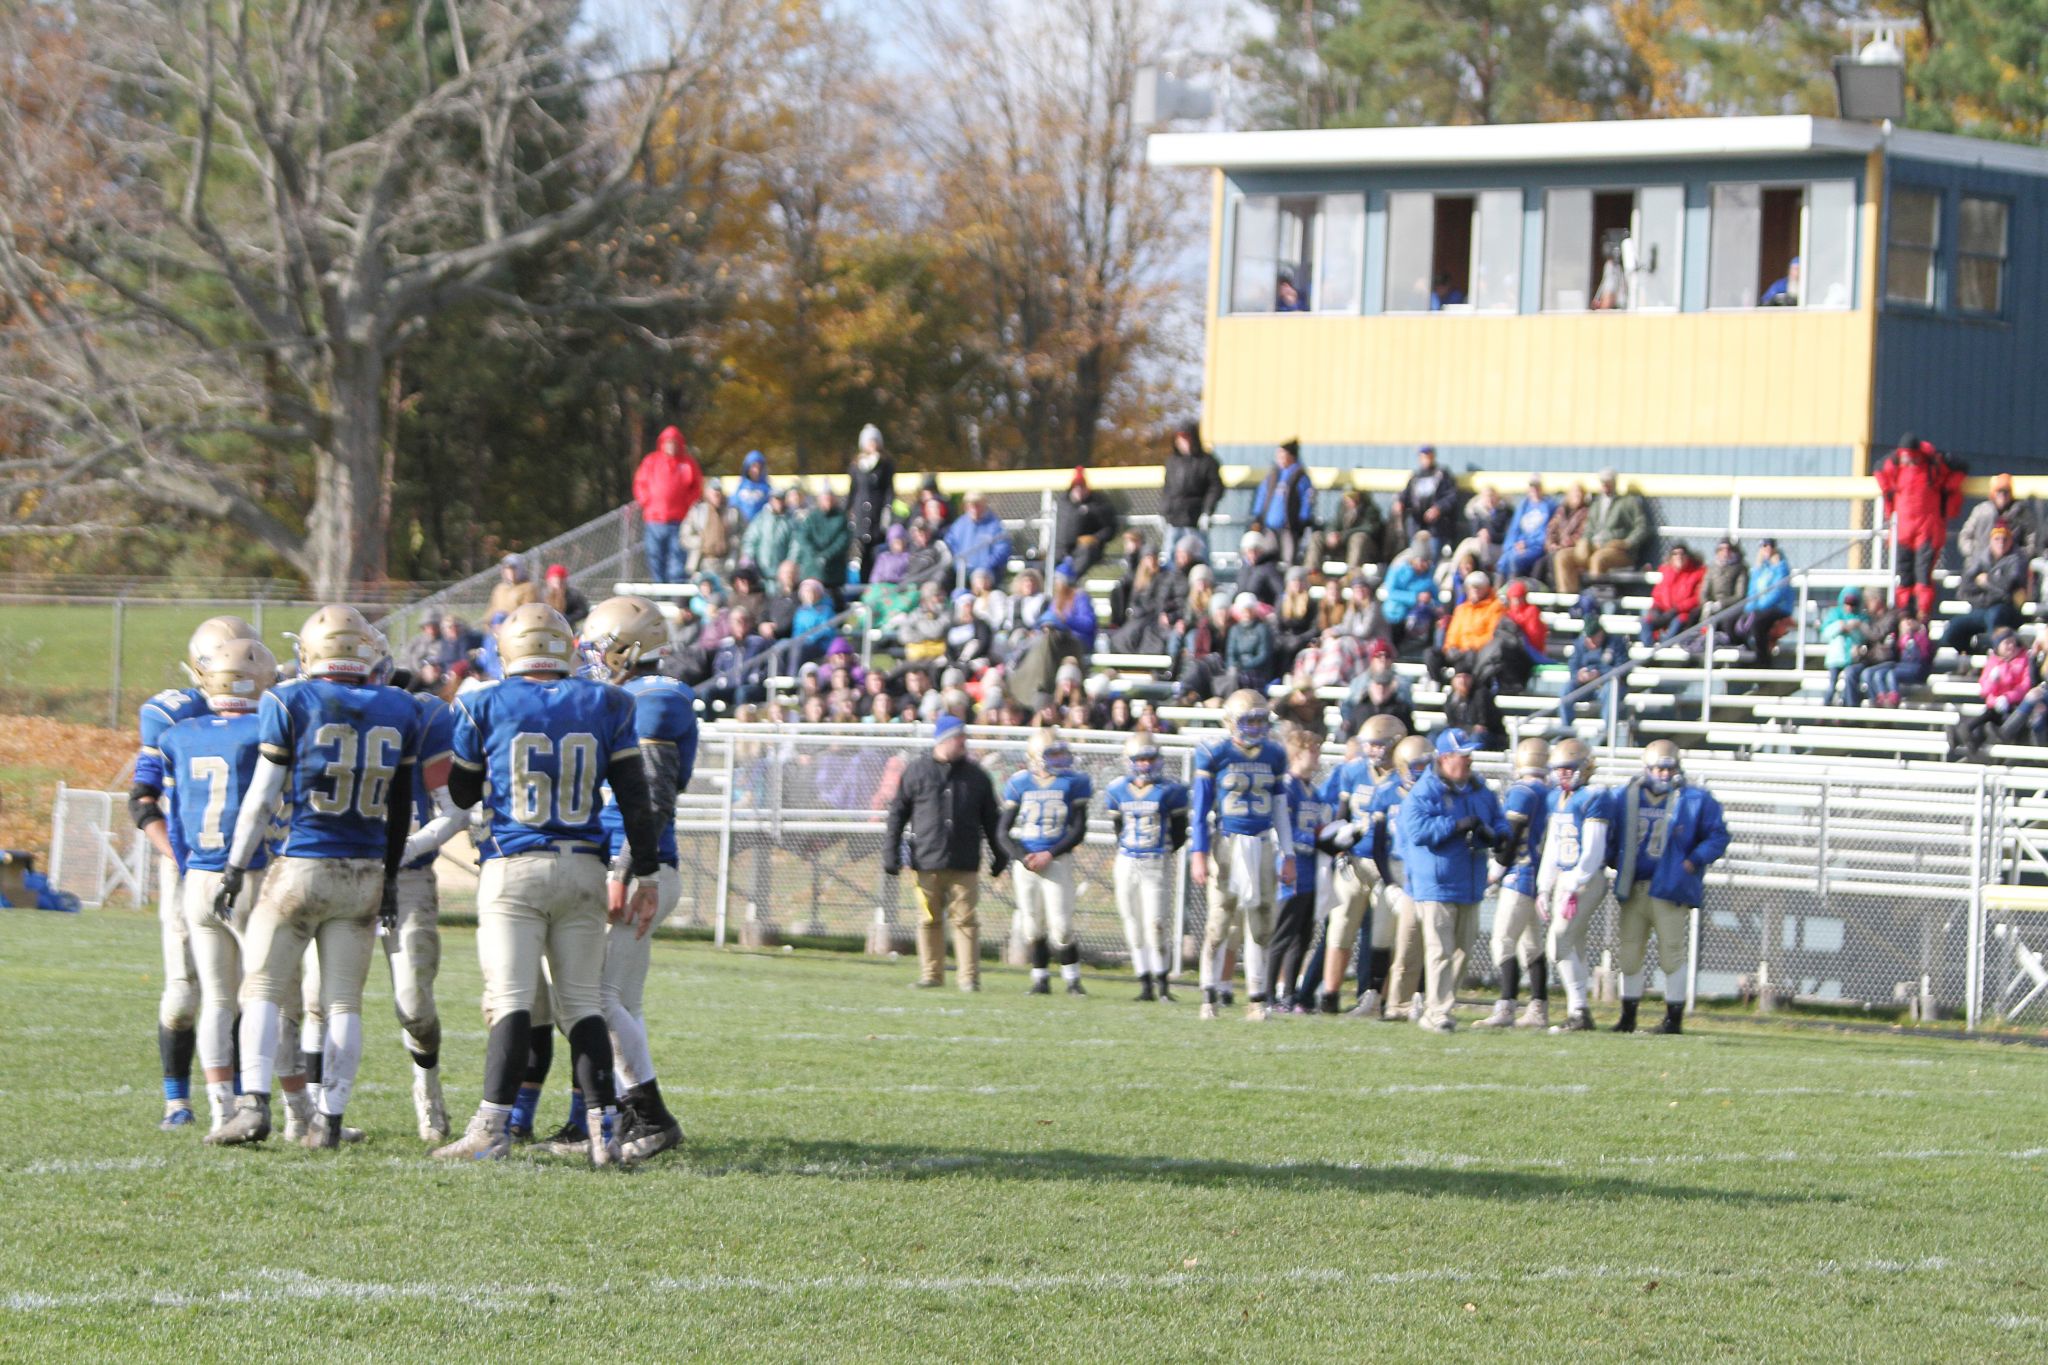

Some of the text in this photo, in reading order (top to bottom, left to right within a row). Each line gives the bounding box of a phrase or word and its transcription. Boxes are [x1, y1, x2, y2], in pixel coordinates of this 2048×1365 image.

[190, 755, 229, 849] 7
[310, 722, 402, 818] 36
[511, 731, 598, 828] 60
[1221, 772, 1275, 816] 25
